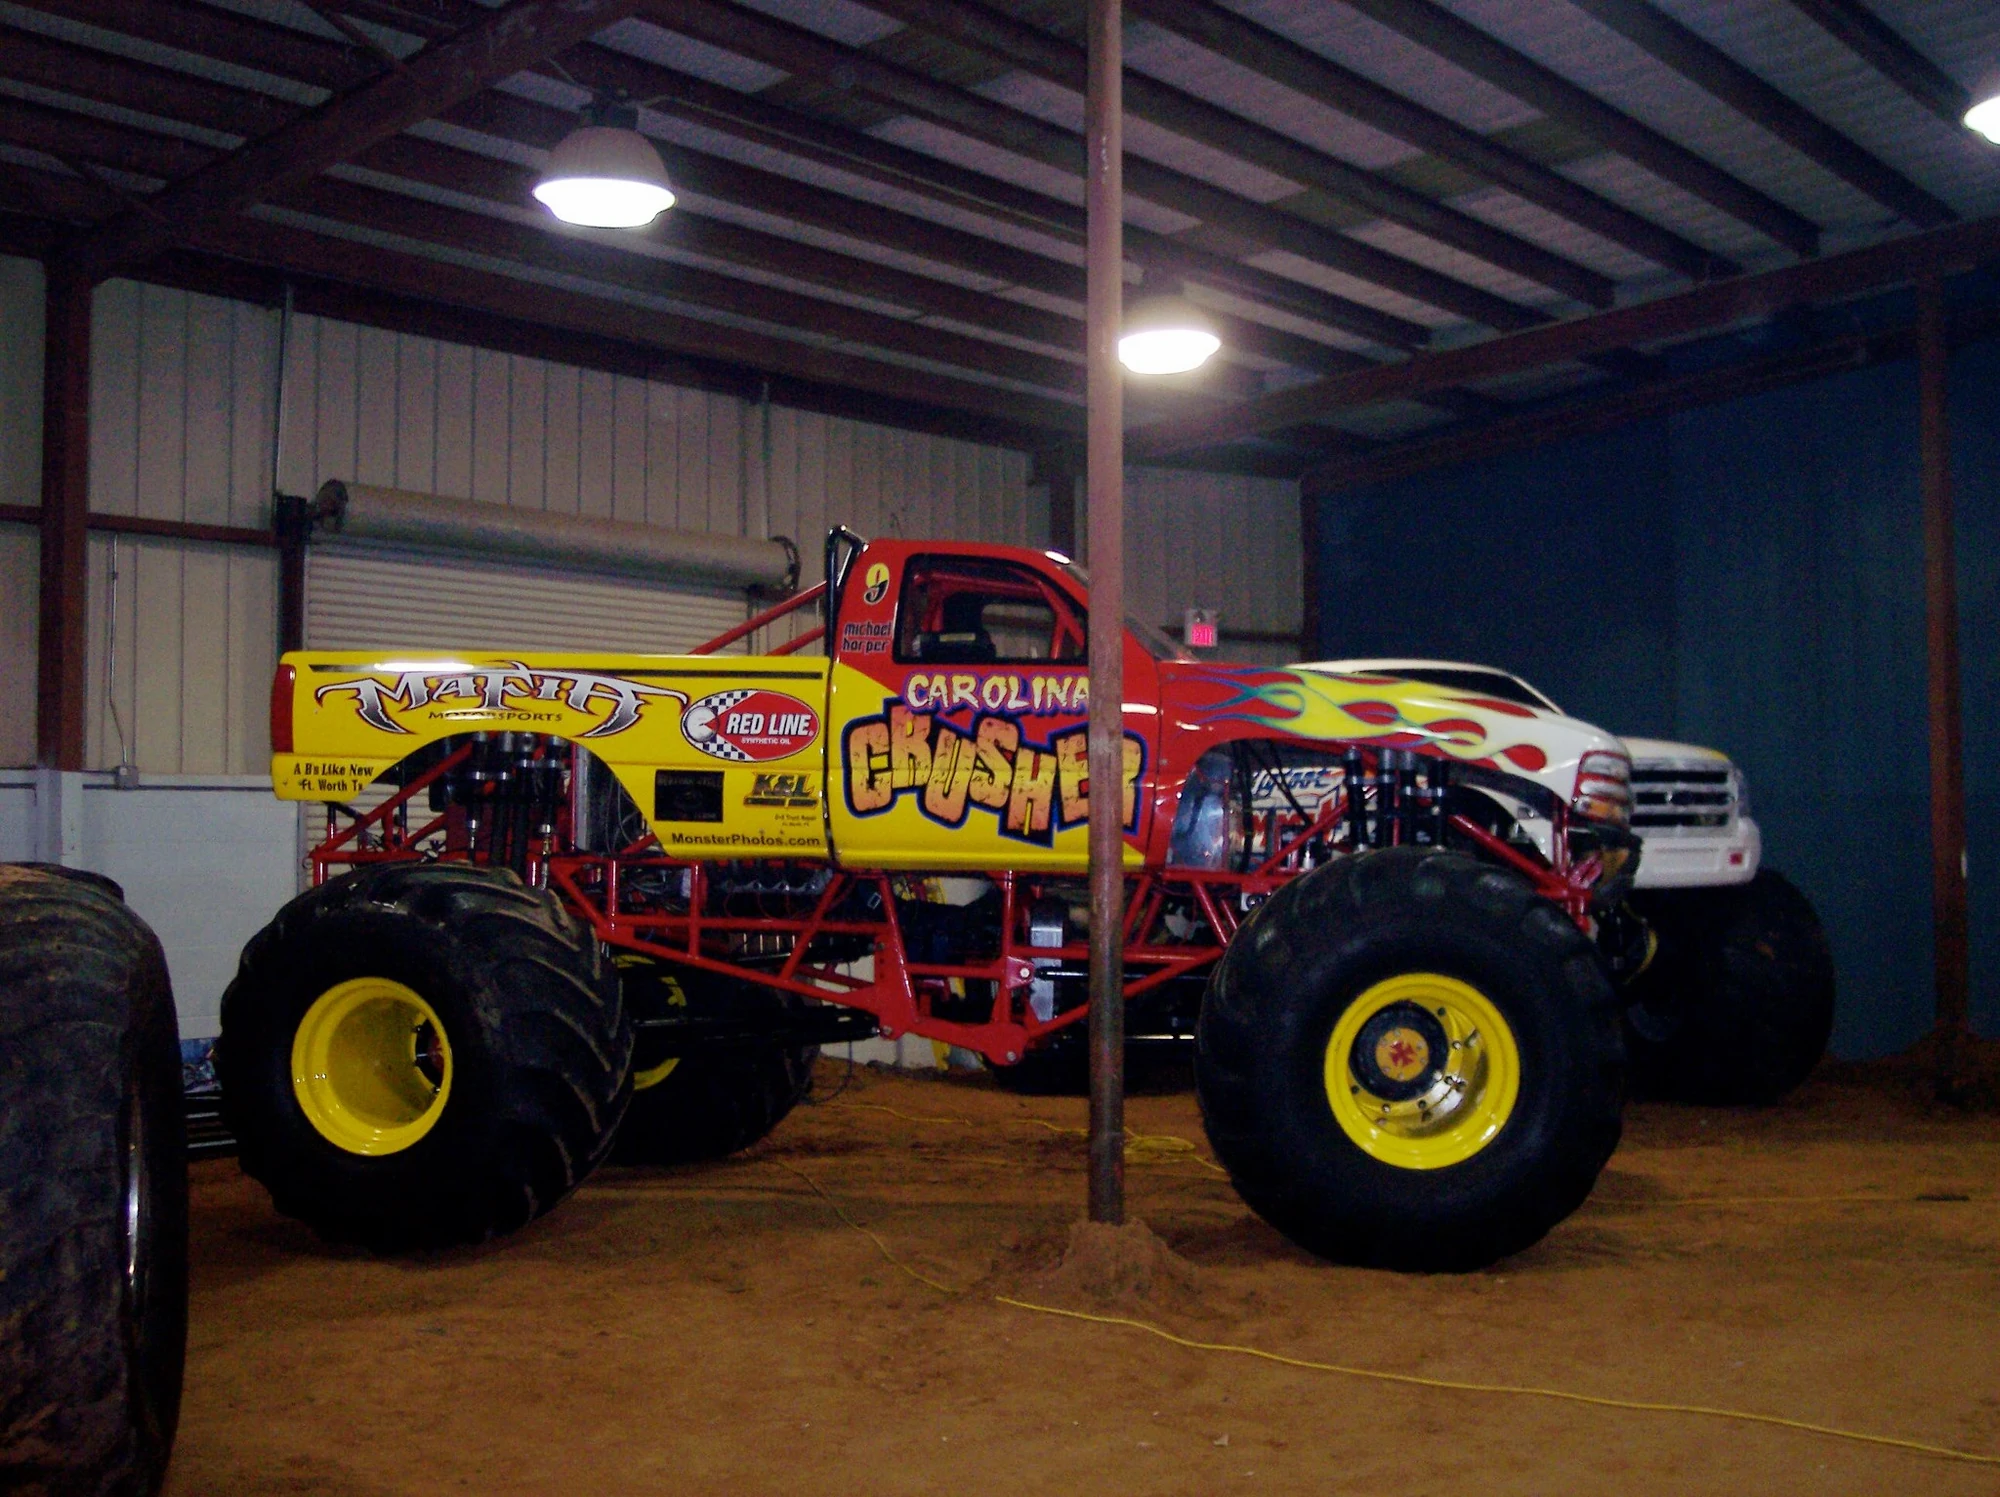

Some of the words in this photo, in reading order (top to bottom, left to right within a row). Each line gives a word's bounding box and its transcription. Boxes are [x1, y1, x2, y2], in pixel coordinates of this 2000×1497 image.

[864, 562, 890, 605] 9
[844, 621, 892, 637] michael
[842, 637, 888, 655] harper
[428, 710, 563, 723] MOTORSPORTS
[726, 713, 765, 735] RED
[741, 736, 778, 745] SYNTHETIC
[780, 737, 792, 745] OIL
[350, 763, 374, 777] New
[318, 779, 347, 792] Worth
[671, 832, 820, 848] MonsterPhotos.com
